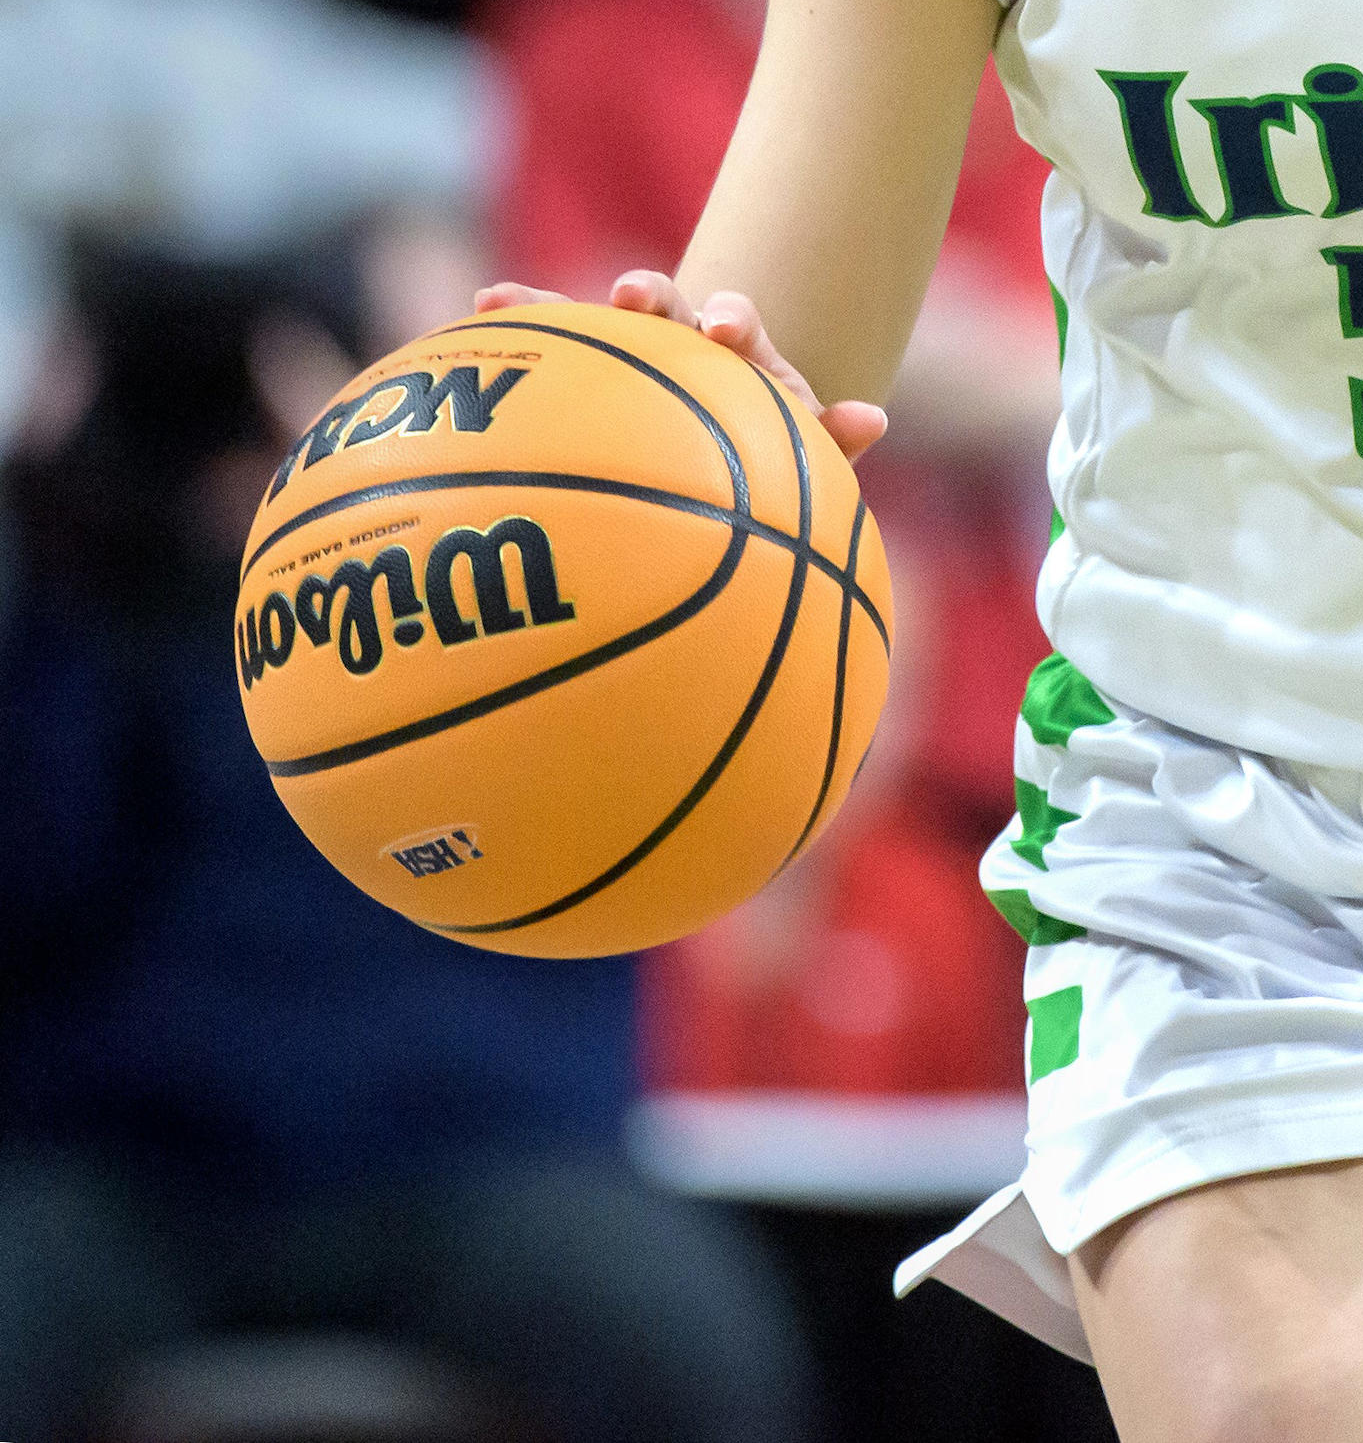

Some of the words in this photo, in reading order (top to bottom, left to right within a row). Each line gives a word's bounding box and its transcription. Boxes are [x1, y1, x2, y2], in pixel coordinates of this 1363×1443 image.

[350, 516, 421, 546] INDOOR
[301, 541, 343, 565] GAME
[268, 560, 296, 578] BALL
[236, 515, 577, 692] Wilson
